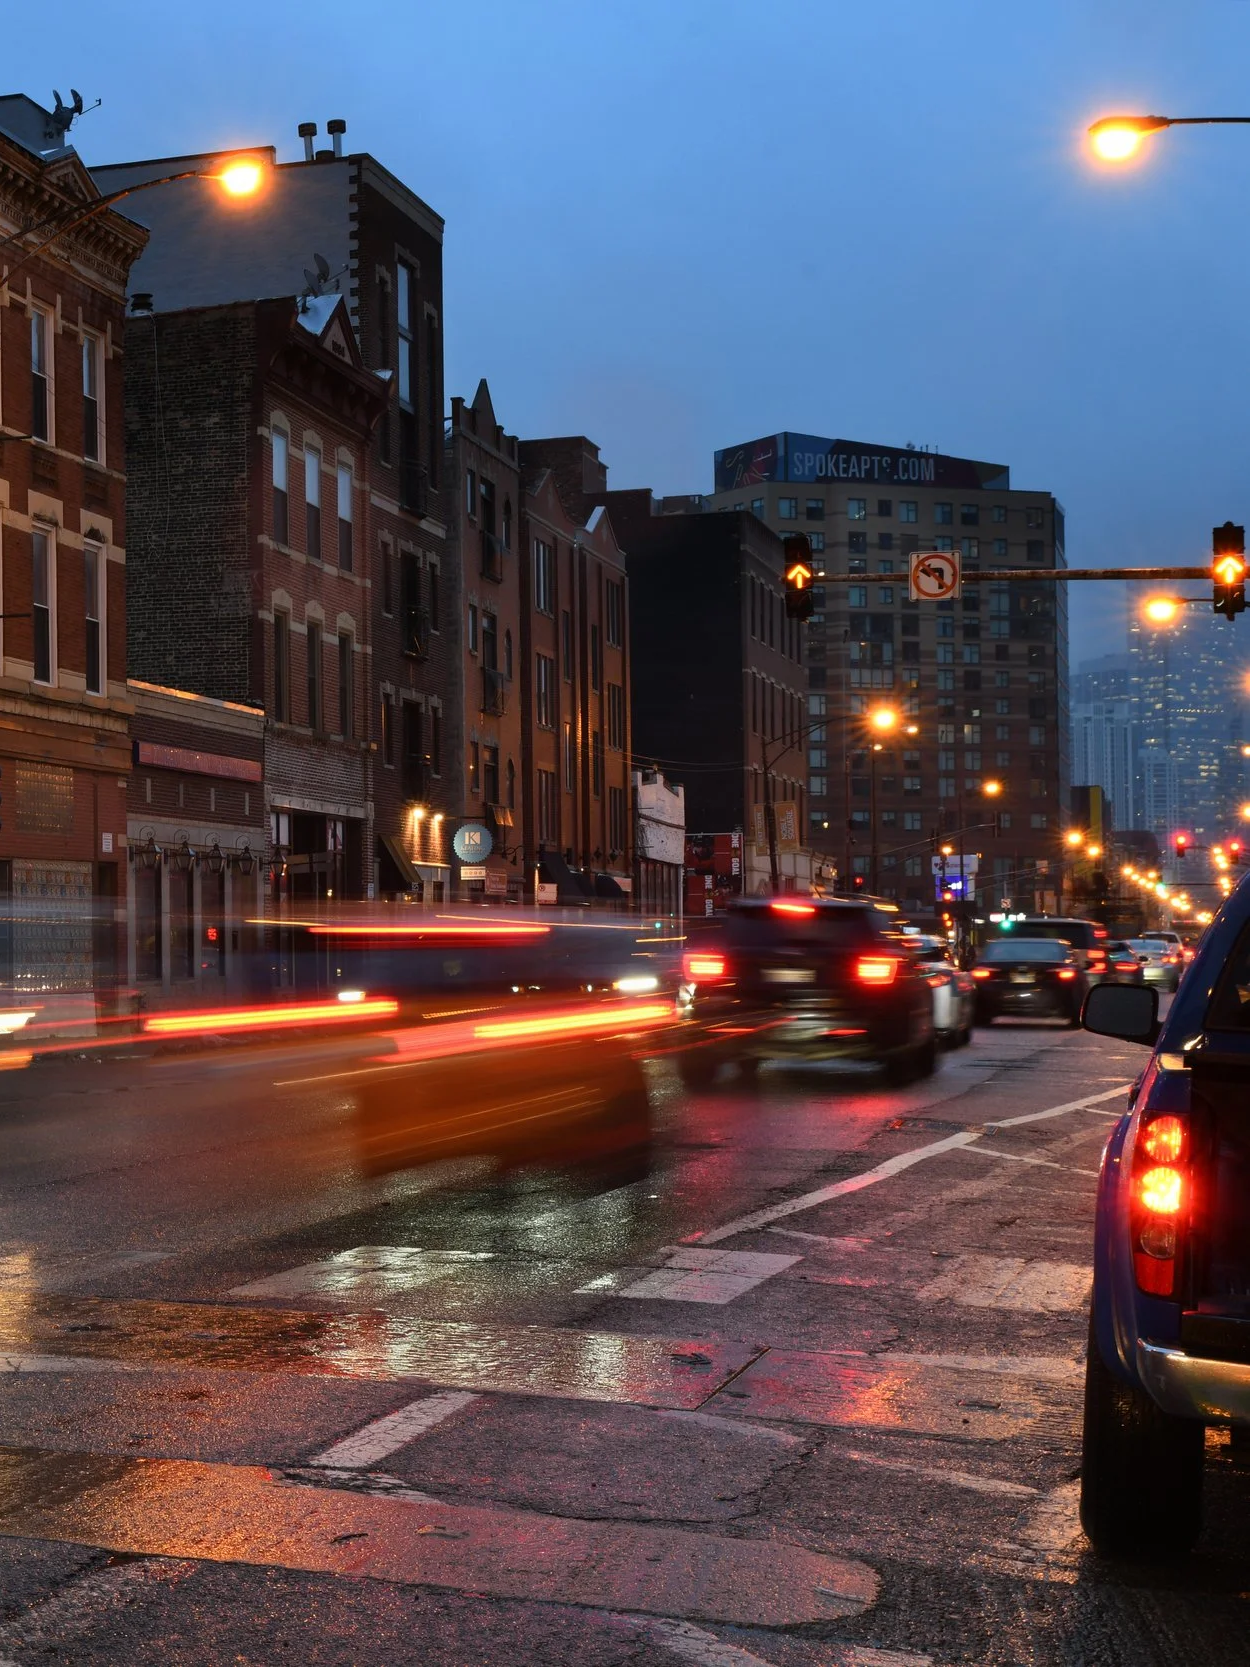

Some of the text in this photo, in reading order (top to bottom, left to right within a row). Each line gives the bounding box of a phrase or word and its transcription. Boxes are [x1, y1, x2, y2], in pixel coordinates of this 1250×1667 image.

[786, 808, 795, 840] SQUARE
[731, 832, 740, 876] ONE GOAL
[704, 874, 714, 918] ONE GOAL
